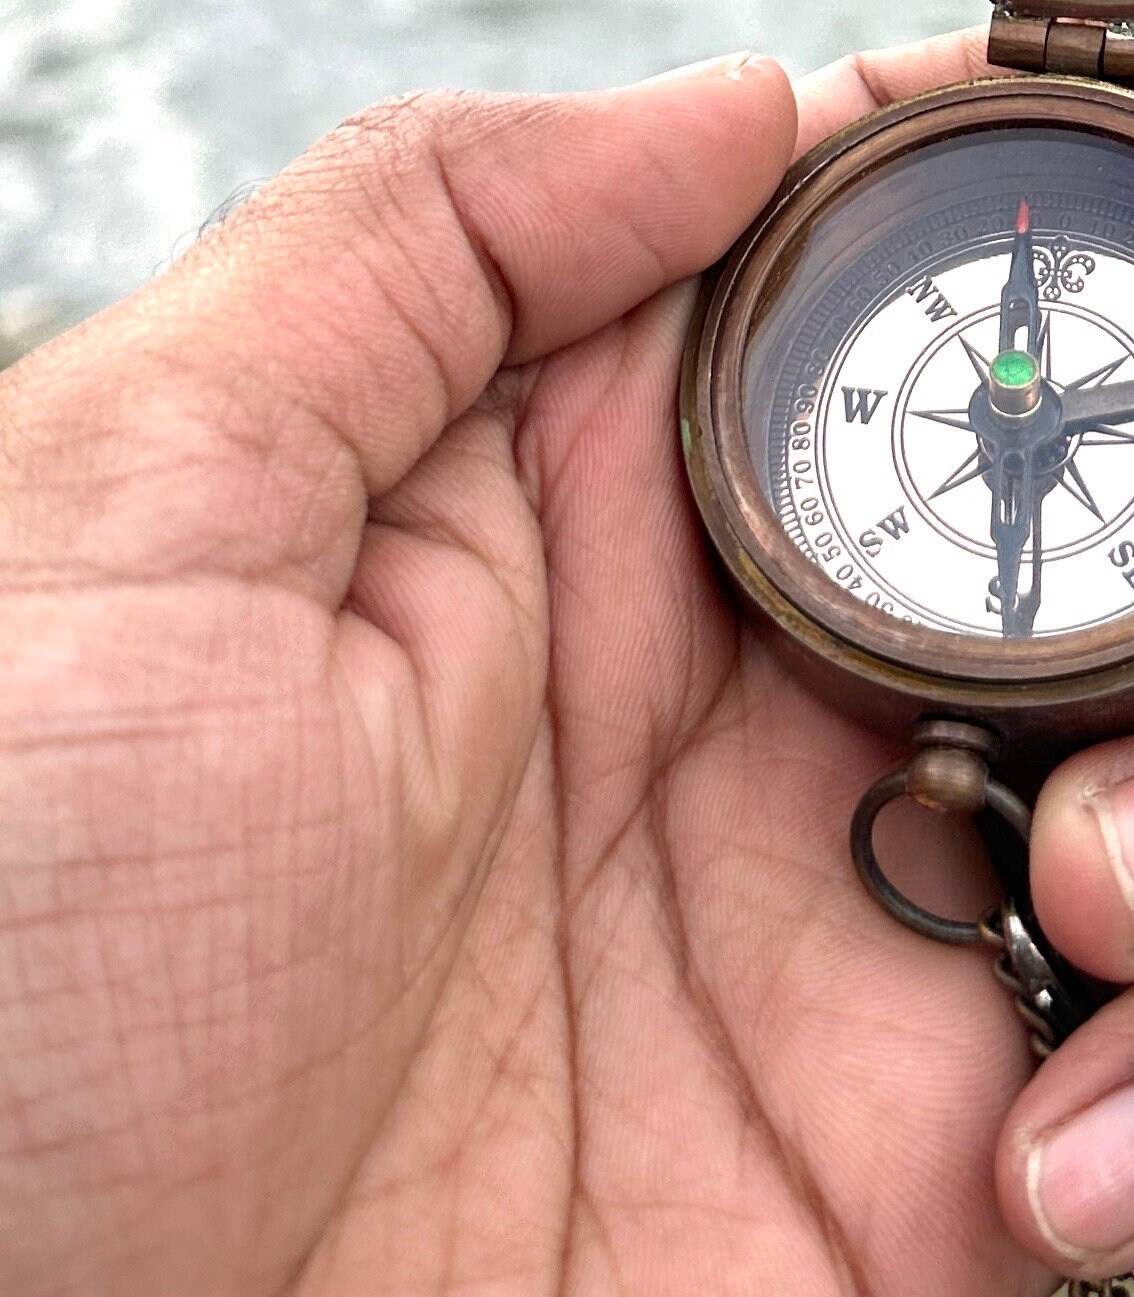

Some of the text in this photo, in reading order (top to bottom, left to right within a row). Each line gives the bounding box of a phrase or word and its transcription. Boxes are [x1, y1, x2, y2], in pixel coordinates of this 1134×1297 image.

[906, 275, 957, 322] NW
[796, 383, 817, 413] 90
[841, 386, 888, 424] W
[792, 420, 811, 451] 80
[793, 459, 814, 489] 70
[800, 496, 824, 526] 60
[815, 532, 841, 562] 50
[859, 505, 910, 559] SW
[837, 564, 862, 591] 40
